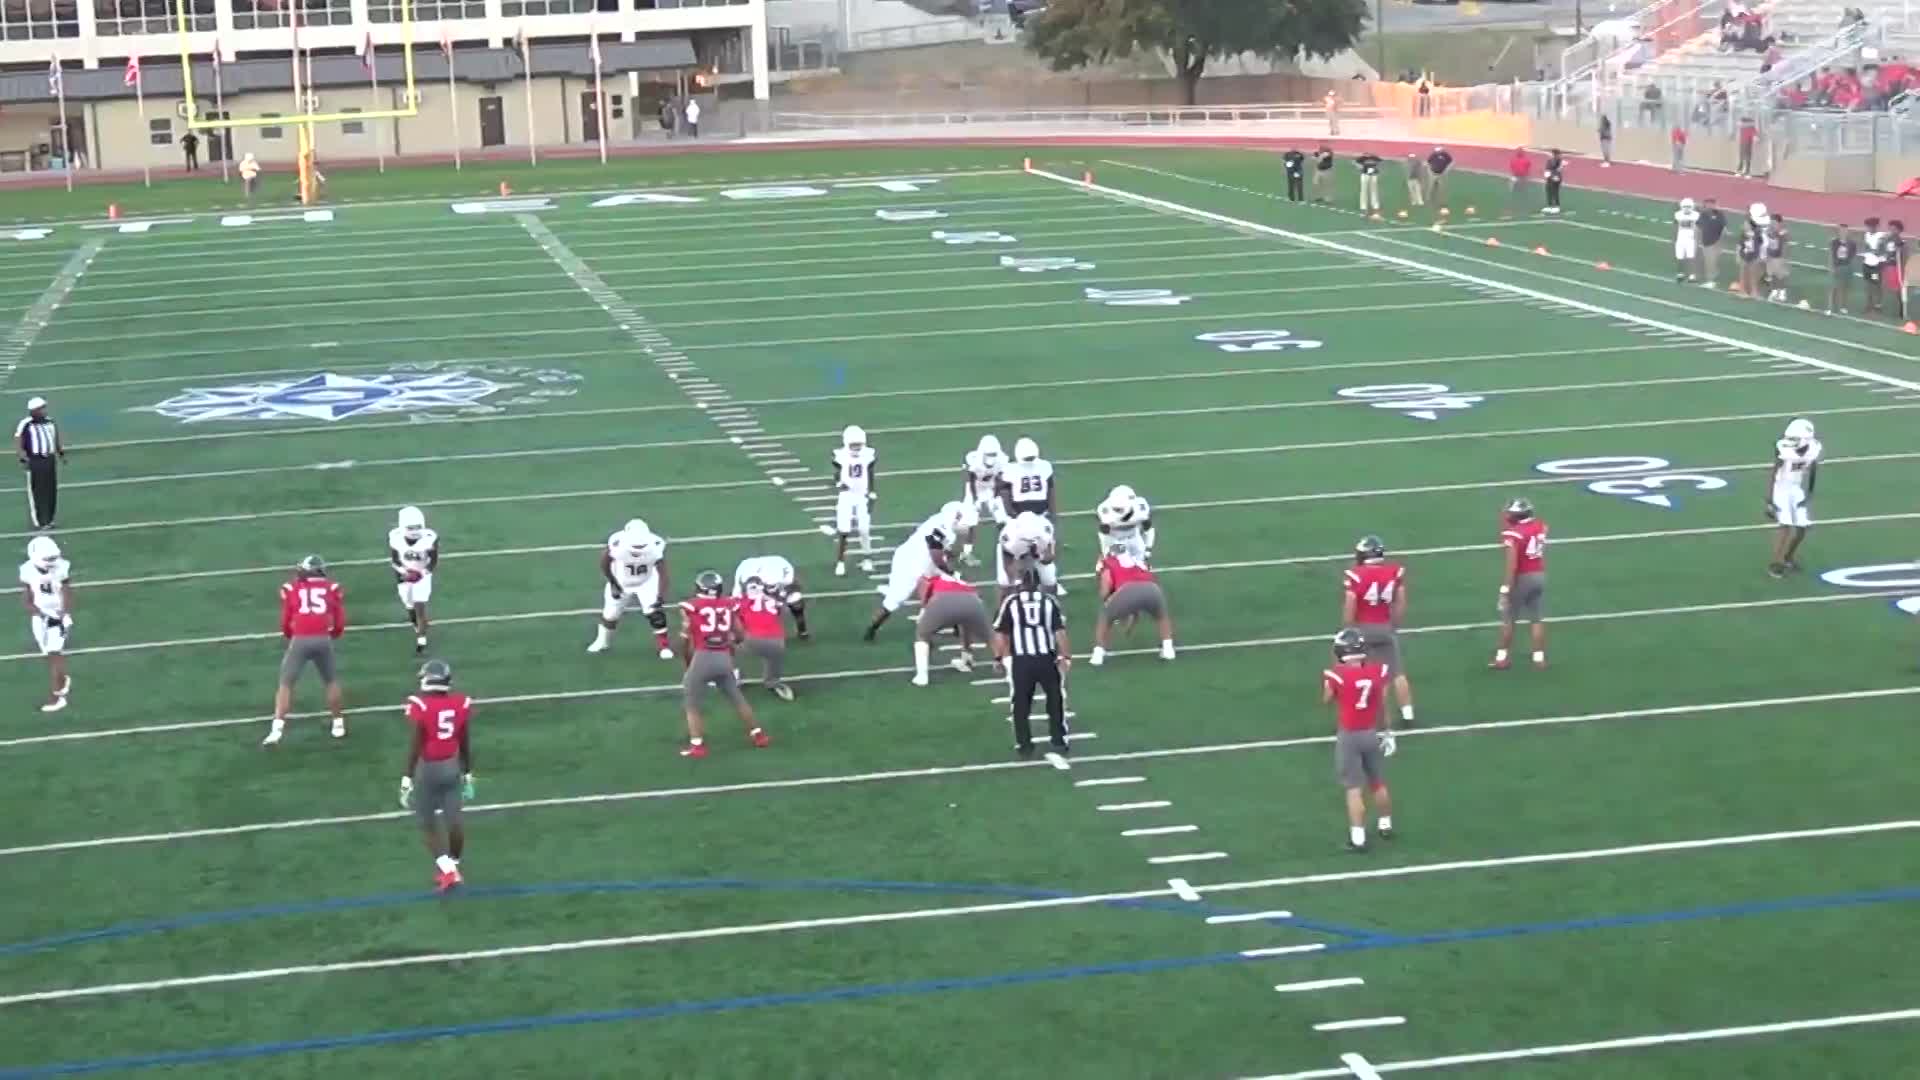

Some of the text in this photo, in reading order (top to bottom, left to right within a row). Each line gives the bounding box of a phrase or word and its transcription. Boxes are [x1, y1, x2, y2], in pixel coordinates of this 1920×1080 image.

[1194, 329, 1324, 353] 50
[1535, 455, 1728, 496] 30
[298, 587, 328, 614] 15
[1363, 580, 1397, 606] 44
[699, 606, 732, 632] 33
[1354, 678, 1373, 710] 7
[436, 709, 456, 740] 5
